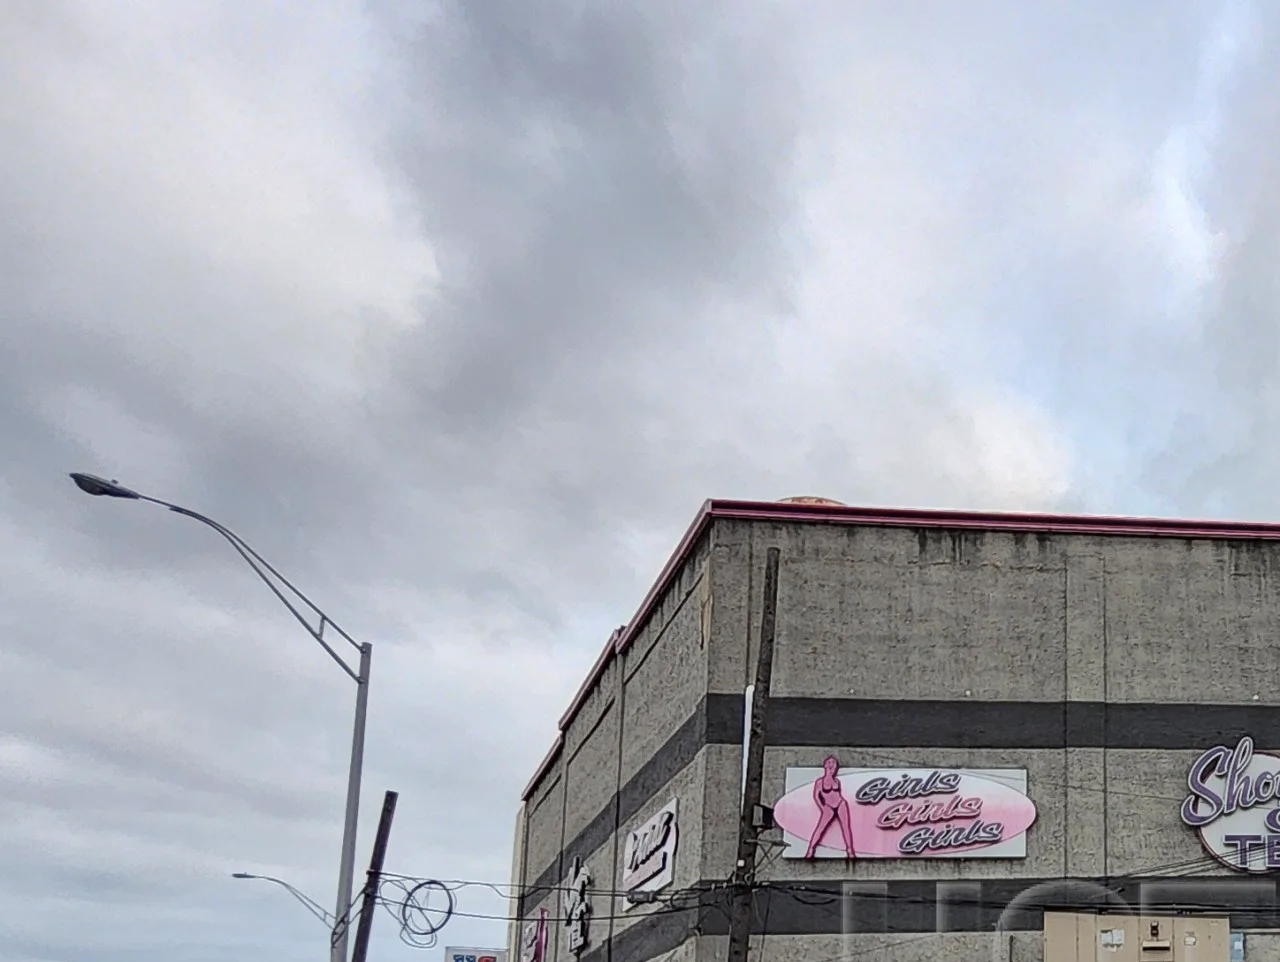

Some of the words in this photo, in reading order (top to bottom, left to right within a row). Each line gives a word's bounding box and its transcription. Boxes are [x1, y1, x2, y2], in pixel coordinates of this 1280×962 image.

[856, 771, 962, 804] Girls
[877, 796, 983, 829] Girls
[899, 821, 1004, 855] Girls
